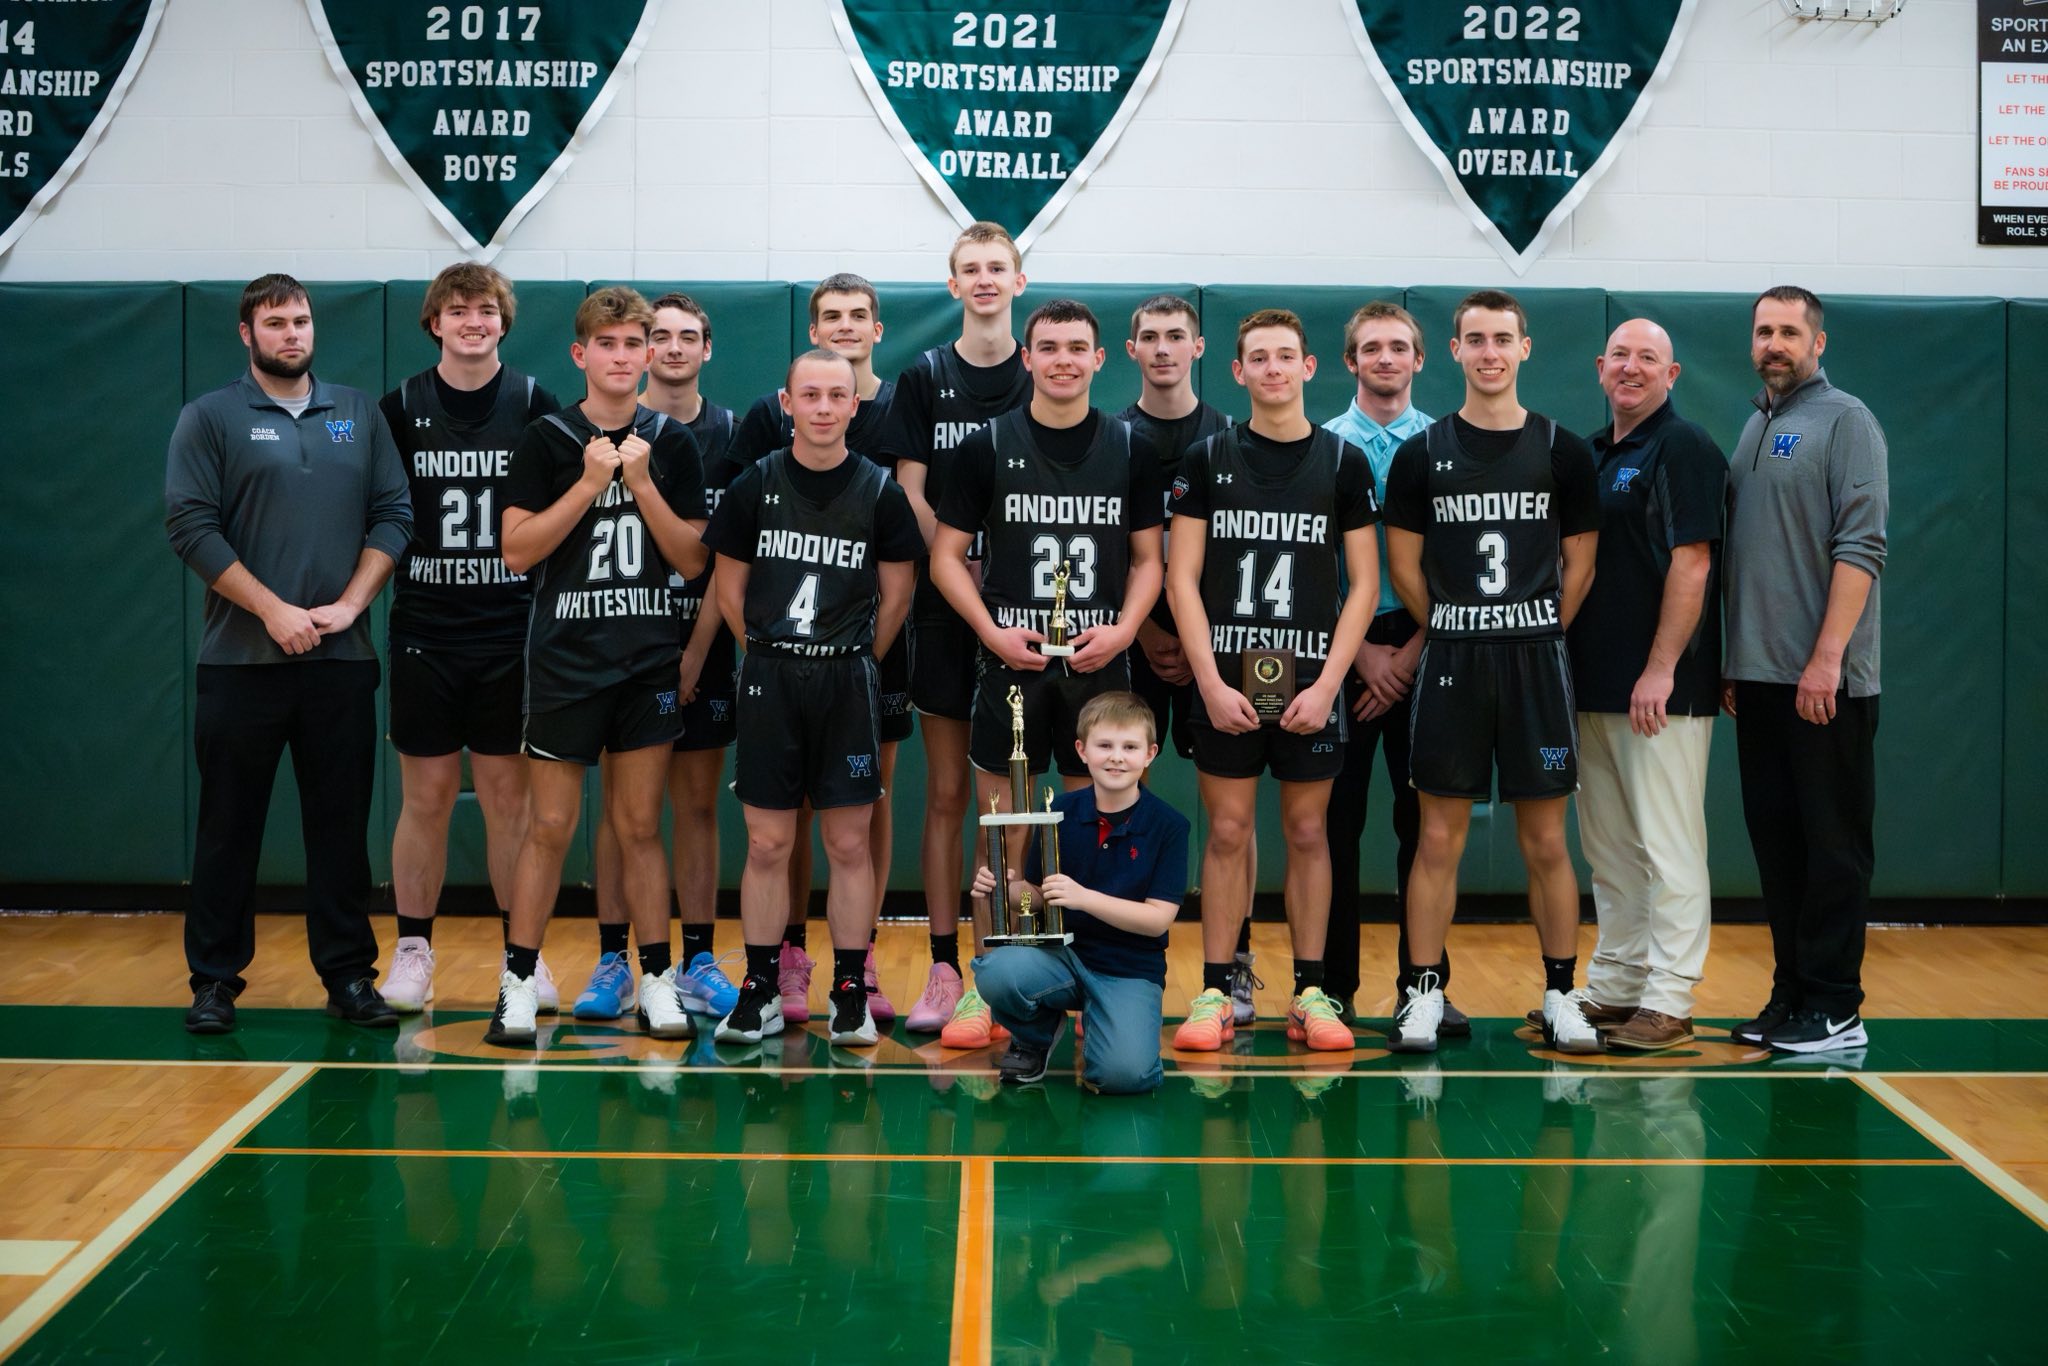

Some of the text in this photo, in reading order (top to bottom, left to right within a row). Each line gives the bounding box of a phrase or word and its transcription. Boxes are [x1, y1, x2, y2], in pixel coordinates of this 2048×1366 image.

[427, 6, 541, 41] 2017
[952, 12, 1057, 48] 2021
[1463, 6, 1581, 41] 2022
[2001, 38, 2025, 52] AN
[366, 60, 598, 88] SPORTSMANSHIP
[887, 61, 1120, 92] SPORTSMANSHIP
[1407, 58, 1632, 89] SPORTSMANSHIP
[2006, 74, 2048, 84] LET TH
[433, 110, 531, 137] AWARD
[954, 109, 1053, 138] AWARD
[1468, 108, 1570, 136] AWARD
[1999, 105, 2046, 115] LET THE
[1989, 136, 2009, 145] LET
[2013, 136, 2035, 146] THE
[444, 155, 517, 182] BOYS
[940, 150, 1067, 180] OVERALL
[1458, 149, 1579, 178] OVERALL
[2005, 167, 2035, 177] FANS
[1993, 181, 2010, 190] BE
[1993, 214, 2025, 224] WHEN
[2006, 227, 2038, 238] ROLE,
[413, 450, 515, 477] ANDOVE
[439, 486, 496, 550] 21
[1005, 493, 1122, 525] ANDOVER
[1432, 491, 1551, 523] ANDOVER
[1213, 509, 1328, 544] ANDOVER
[586, 512, 645, 583] 20
[756, 530, 867, 570] ANDOVER
[1031, 534, 1097, 601] 23
[1476, 531, 1509, 598] 3
[1234, 550, 1295, 620] 14
[555, 587, 672, 619] WHITESVILLE
[786, 572, 821, 638] 4
[1431, 600, 1558, 631] WHITESVILLE
[1211, 625, 1328, 660] HITESVILLE
